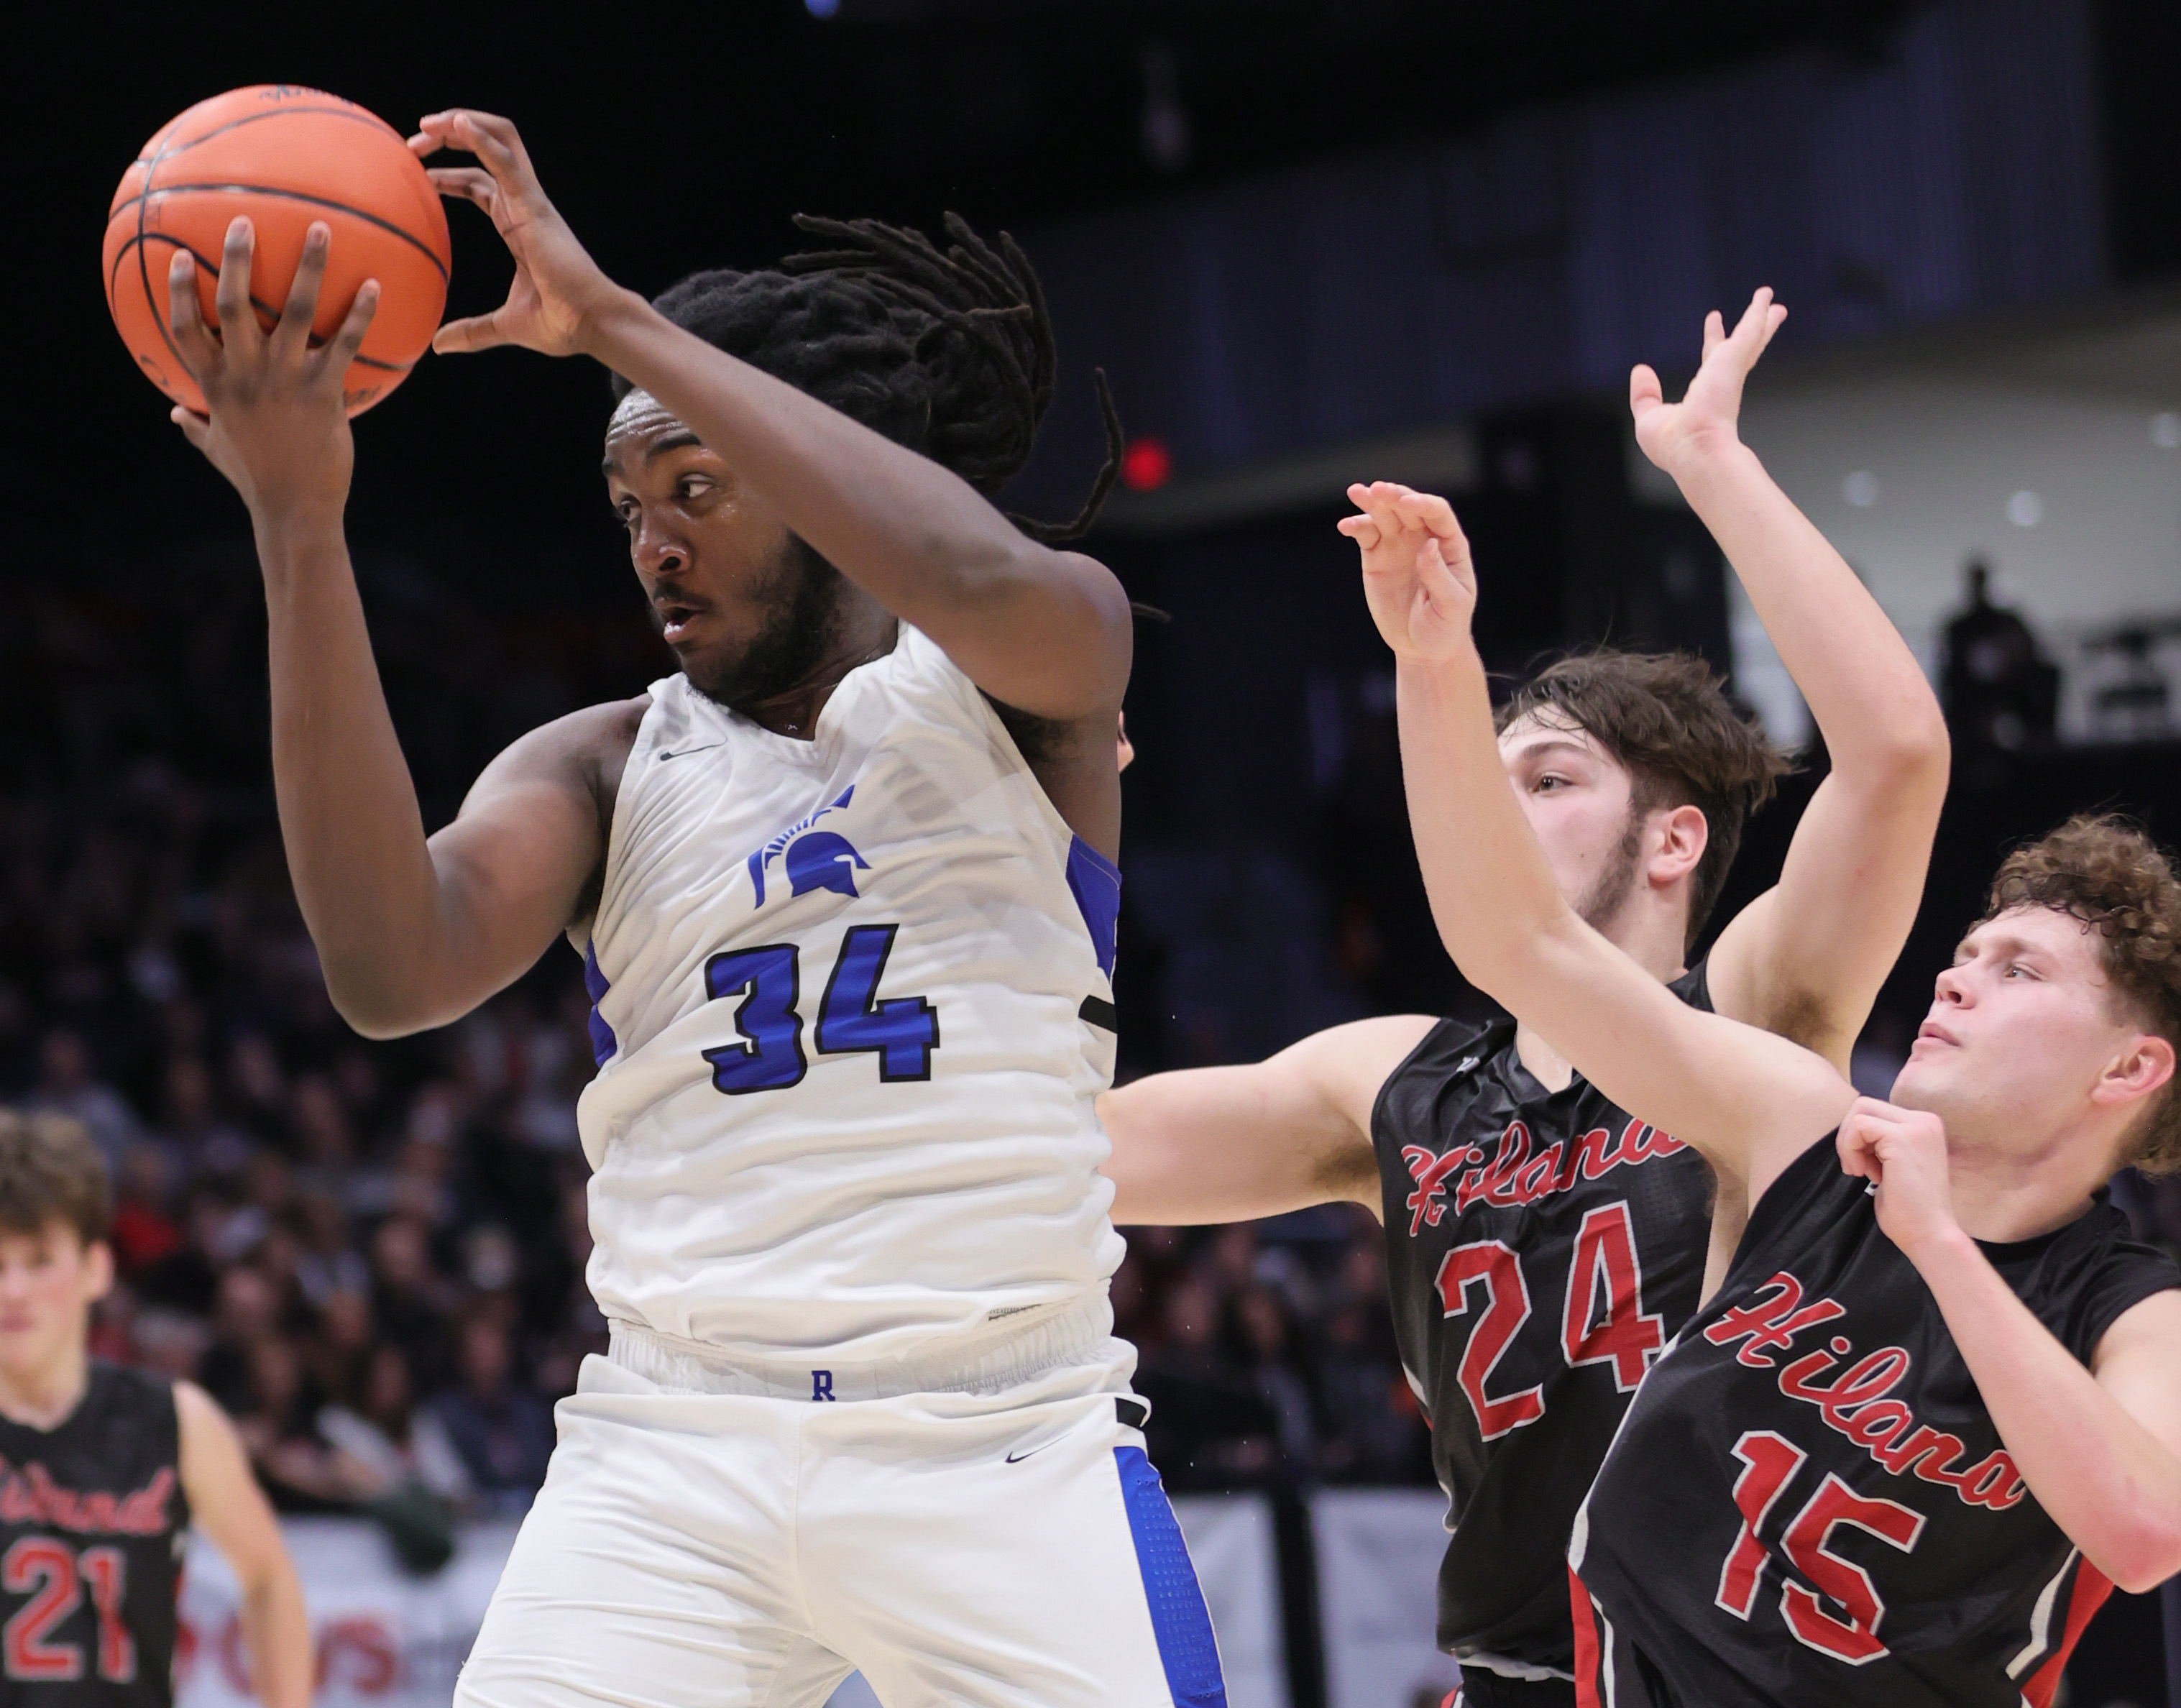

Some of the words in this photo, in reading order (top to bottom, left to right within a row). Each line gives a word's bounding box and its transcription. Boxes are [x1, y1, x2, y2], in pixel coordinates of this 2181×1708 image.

[701, 923, 940, 1096] 34
[811, 1370, 836, 1401] R
[1434, 1199, 1666, 1443] 24
[2, 1535, 137, 1684] 21
[1714, 1430, 1928, 1666] 15
